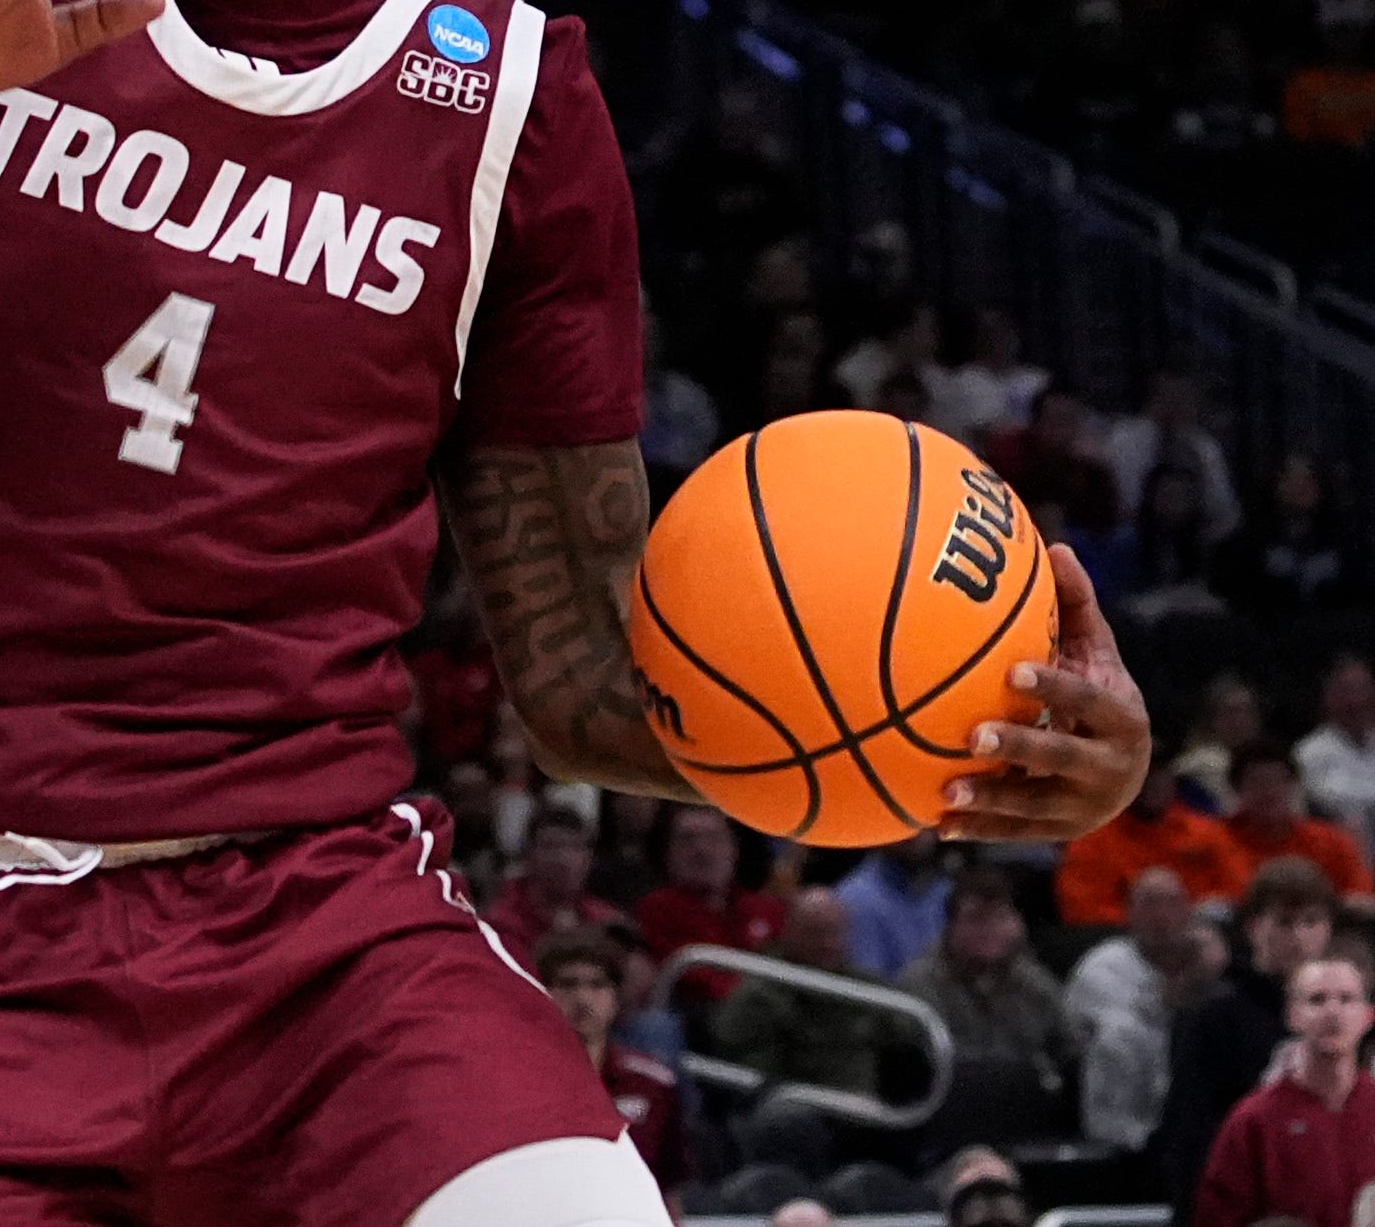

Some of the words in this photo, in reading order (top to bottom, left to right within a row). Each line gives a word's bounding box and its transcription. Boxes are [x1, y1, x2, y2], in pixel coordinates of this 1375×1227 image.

[434, 24, 484, 56] NCAA
[396, 49, 491, 115] SBC
[102, 291, 217, 475] 4
